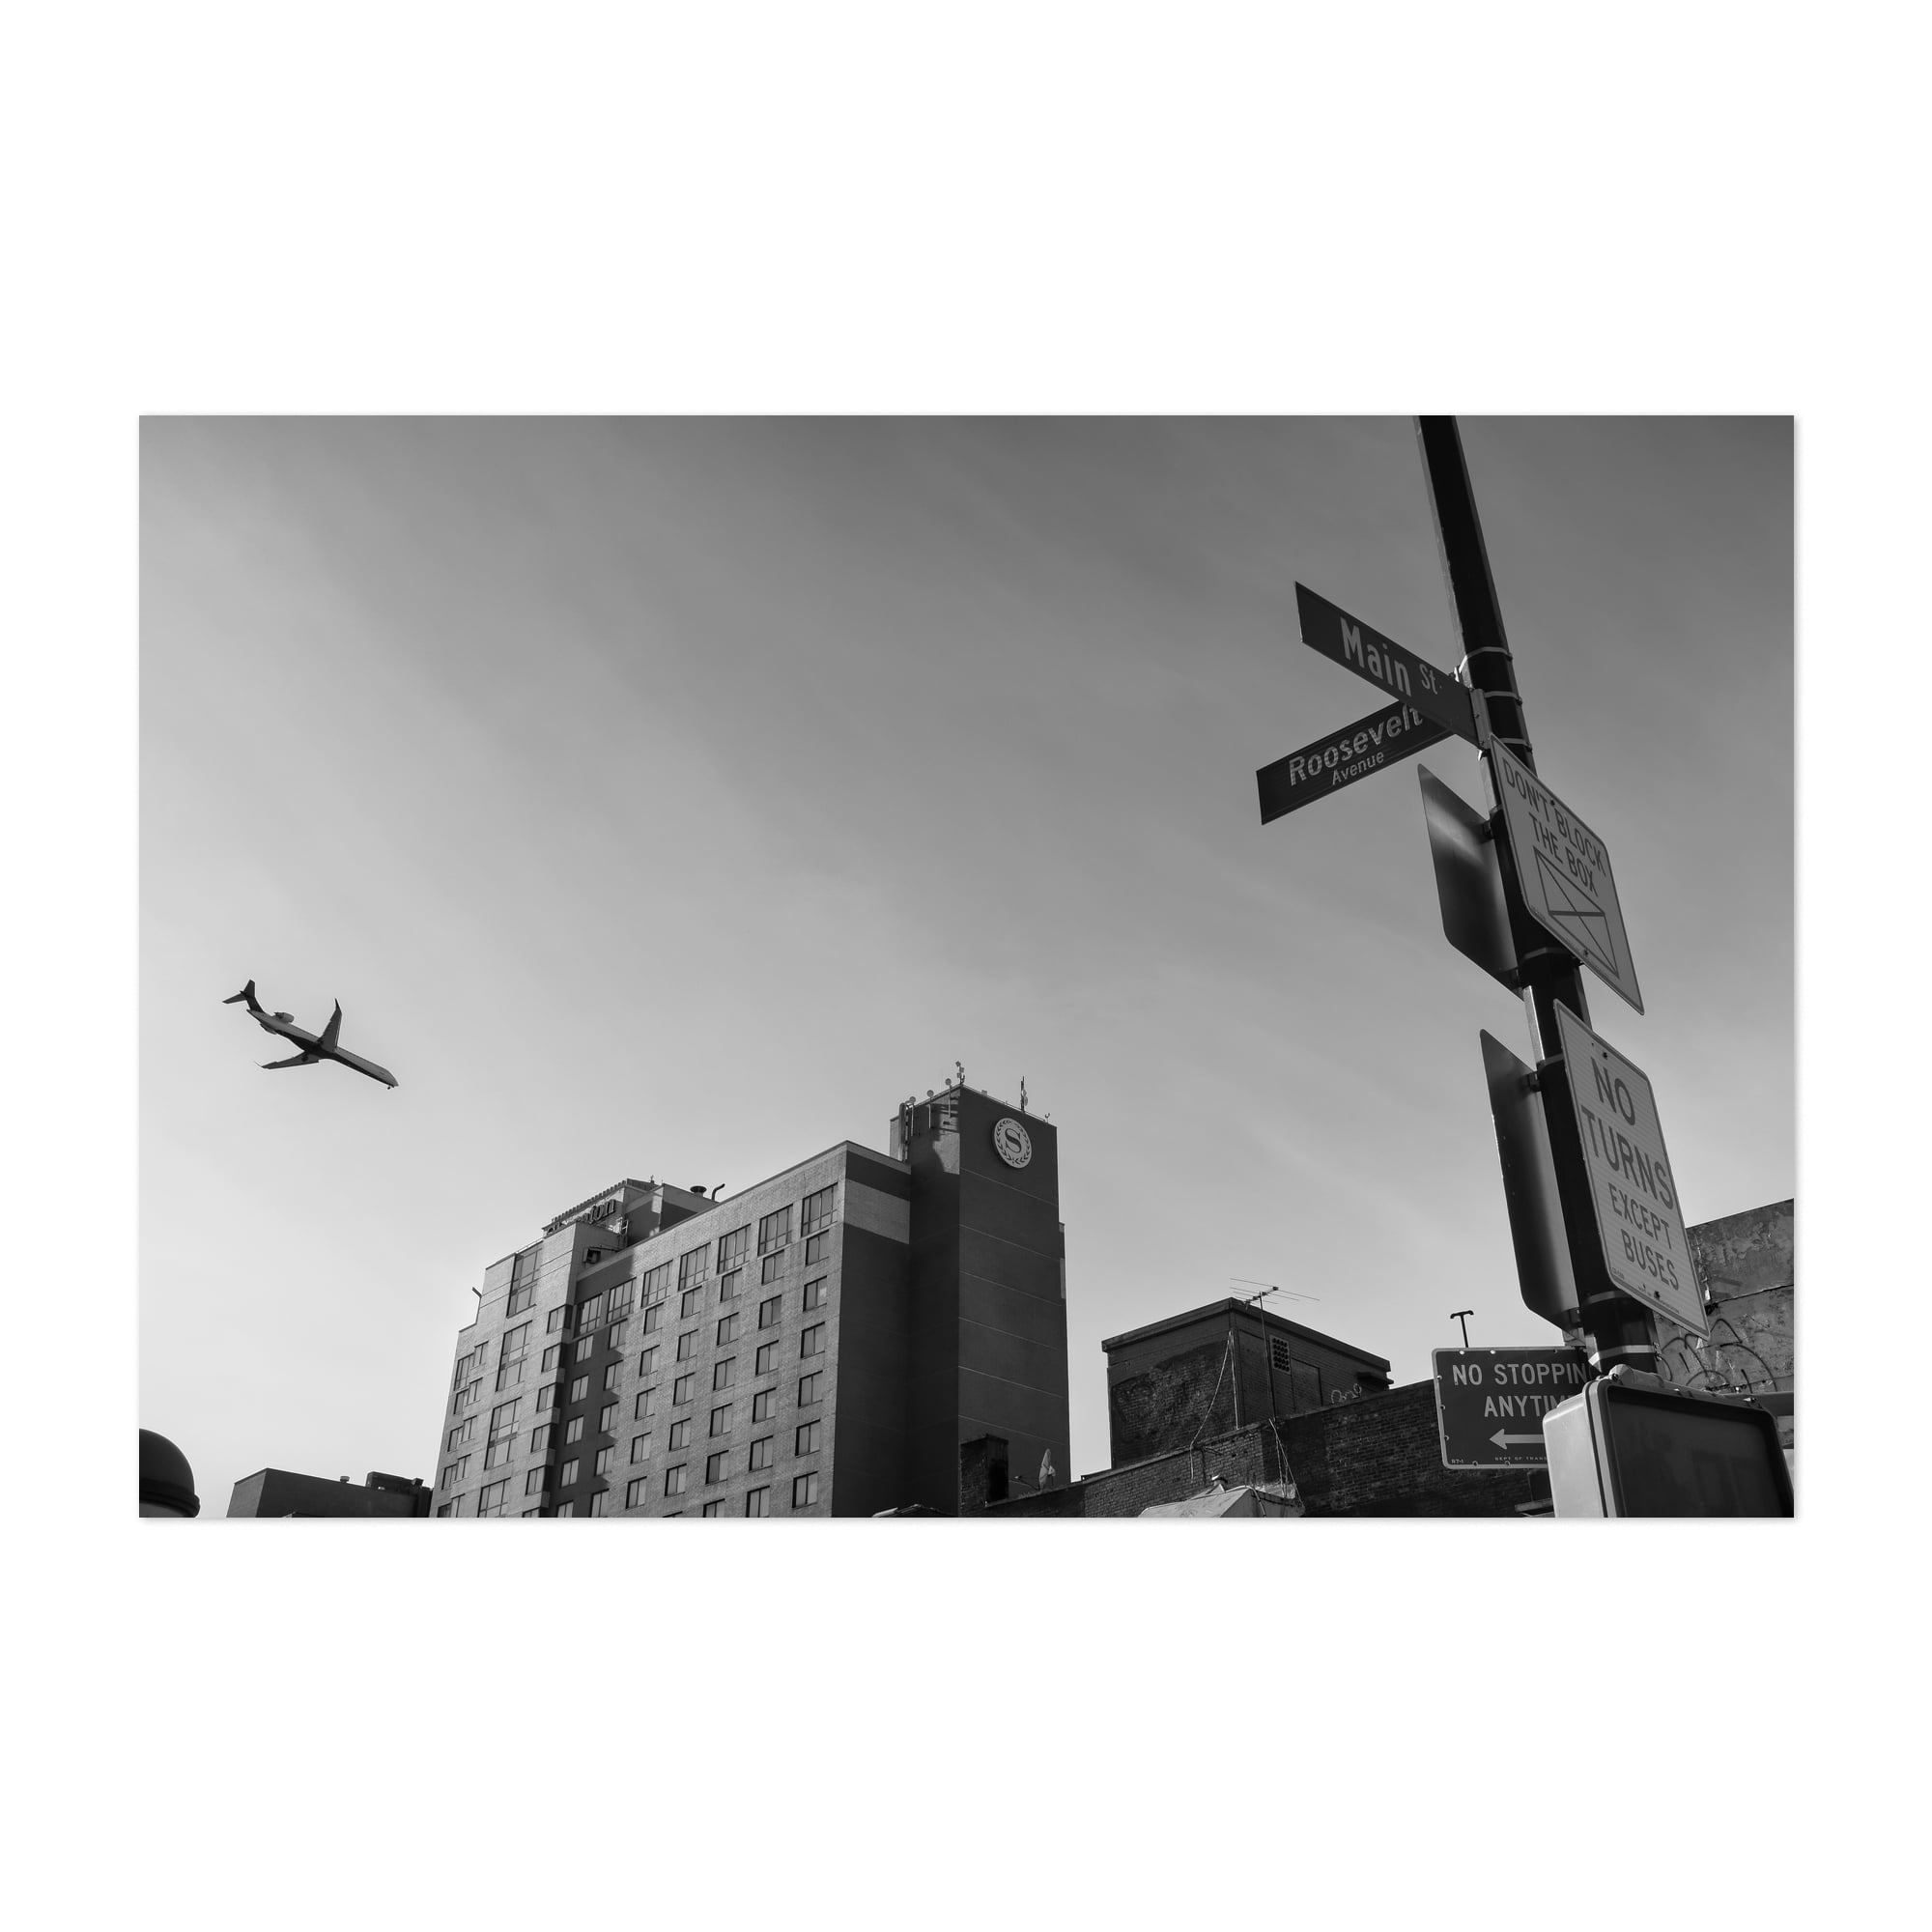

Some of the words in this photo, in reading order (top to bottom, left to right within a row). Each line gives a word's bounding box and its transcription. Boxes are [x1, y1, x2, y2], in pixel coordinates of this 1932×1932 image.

[1340, 616, 1411, 696] Main
[1289, 703, 1423, 787] Roosevelt
[1332, 751, 1384, 785] Avenue
[1502, 757, 1550, 824] DON'T
[1554, 810, 1606, 876] BLOCK
[1528, 811, 1563, 864] THE
[1565, 846, 1598, 896] BOX
[1591, 1057, 1635, 1126] NO
[1581, 1105, 1673, 1209] TURNS
[1608, 1182, 1672, 1249] EXCEPT
[1621, 1229, 1679, 1291] BUSES
[1452, 1364, 1483, 1385] NO
[1493, 1363, 1592, 1384] STOPPIN
[1484, 1396, 1573, 1417] ANYTI
